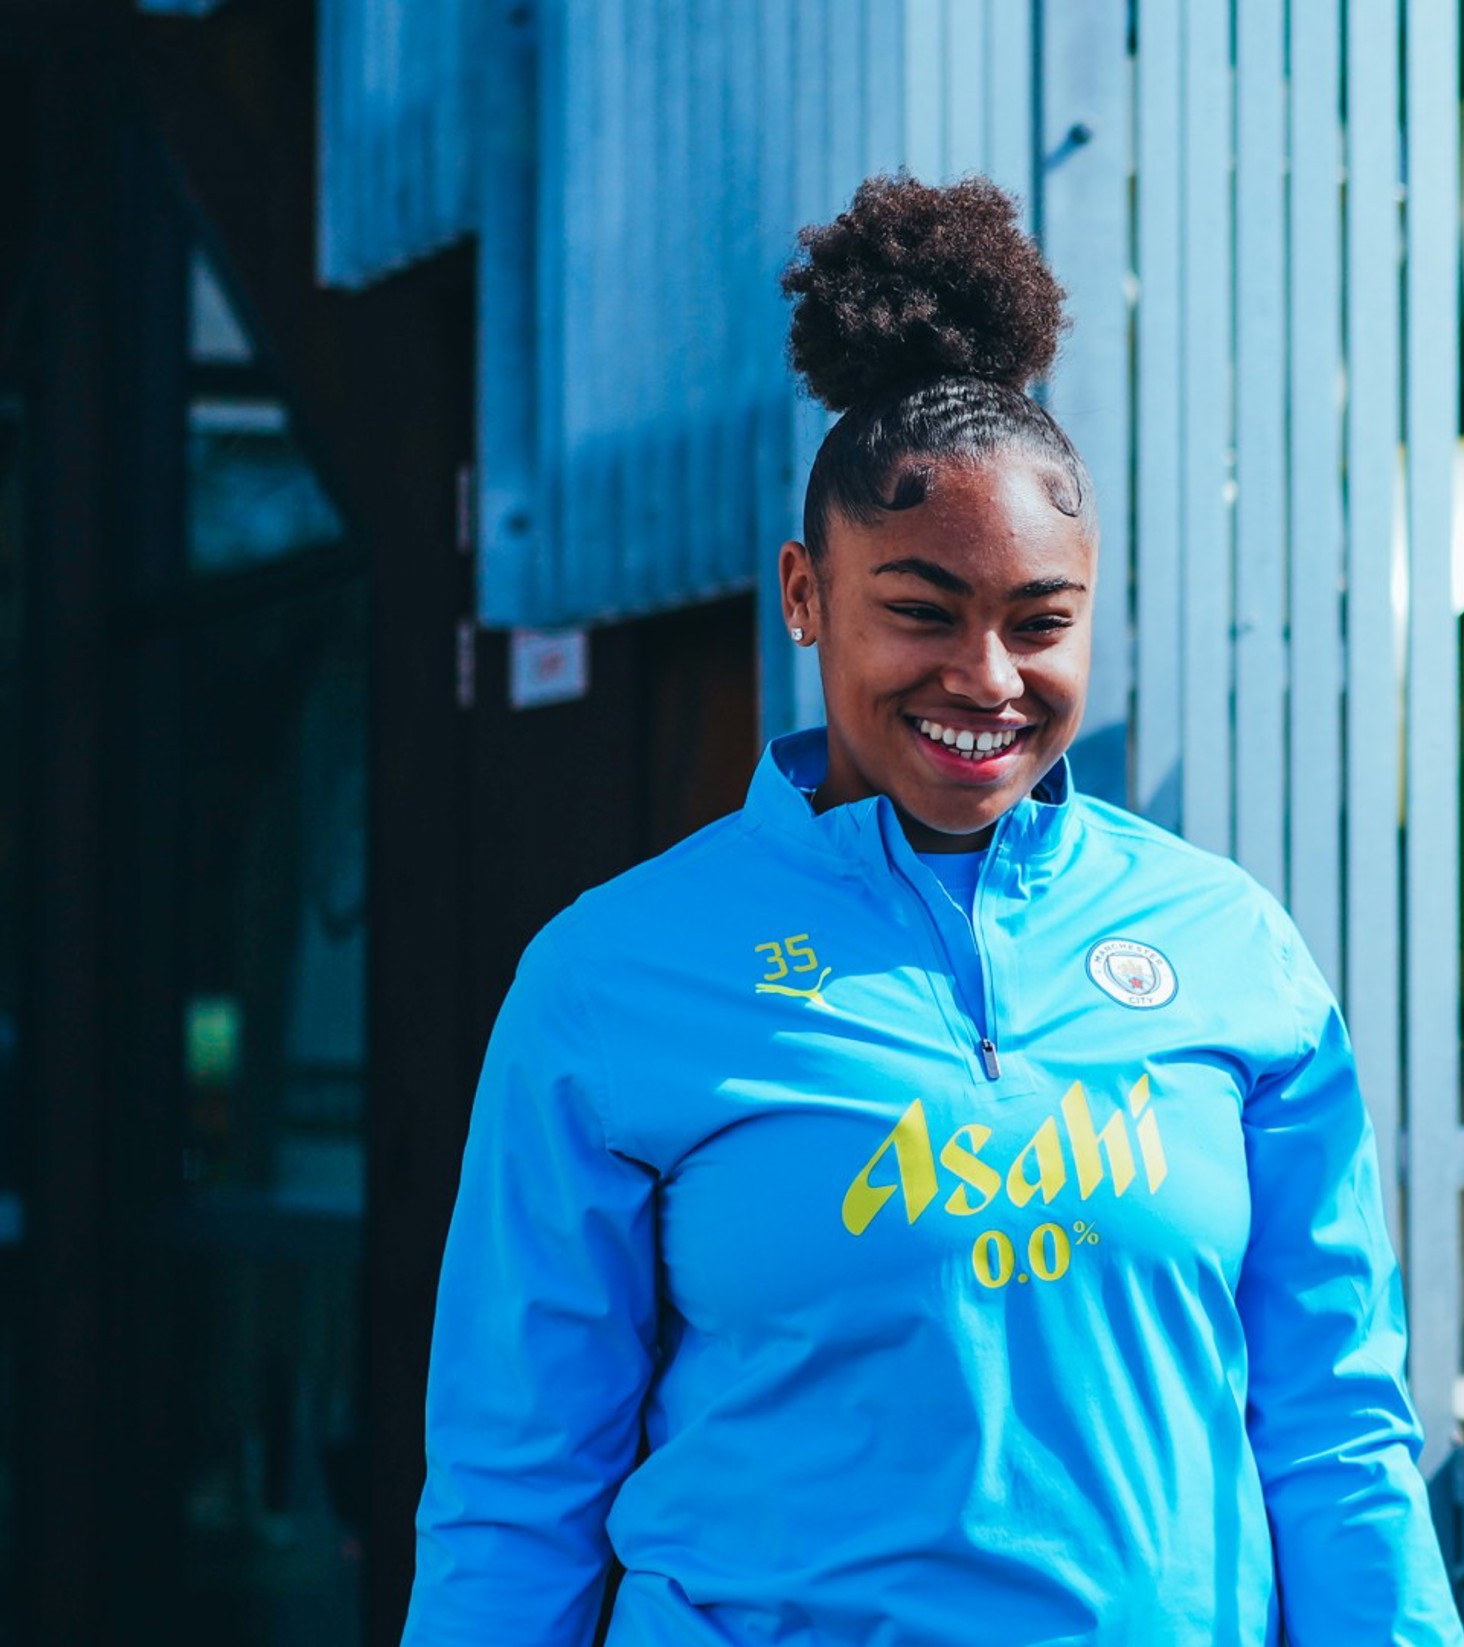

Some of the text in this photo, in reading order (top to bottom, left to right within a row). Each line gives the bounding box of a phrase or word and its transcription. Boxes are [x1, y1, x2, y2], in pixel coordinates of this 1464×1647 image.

[754, 933, 819, 981] 35
[1095, 943, 1163, 965] MANCHESTER
[841, 1073, 1169, 1236] Asahi
[972, 1220, 1100, 1288] 0.0%
